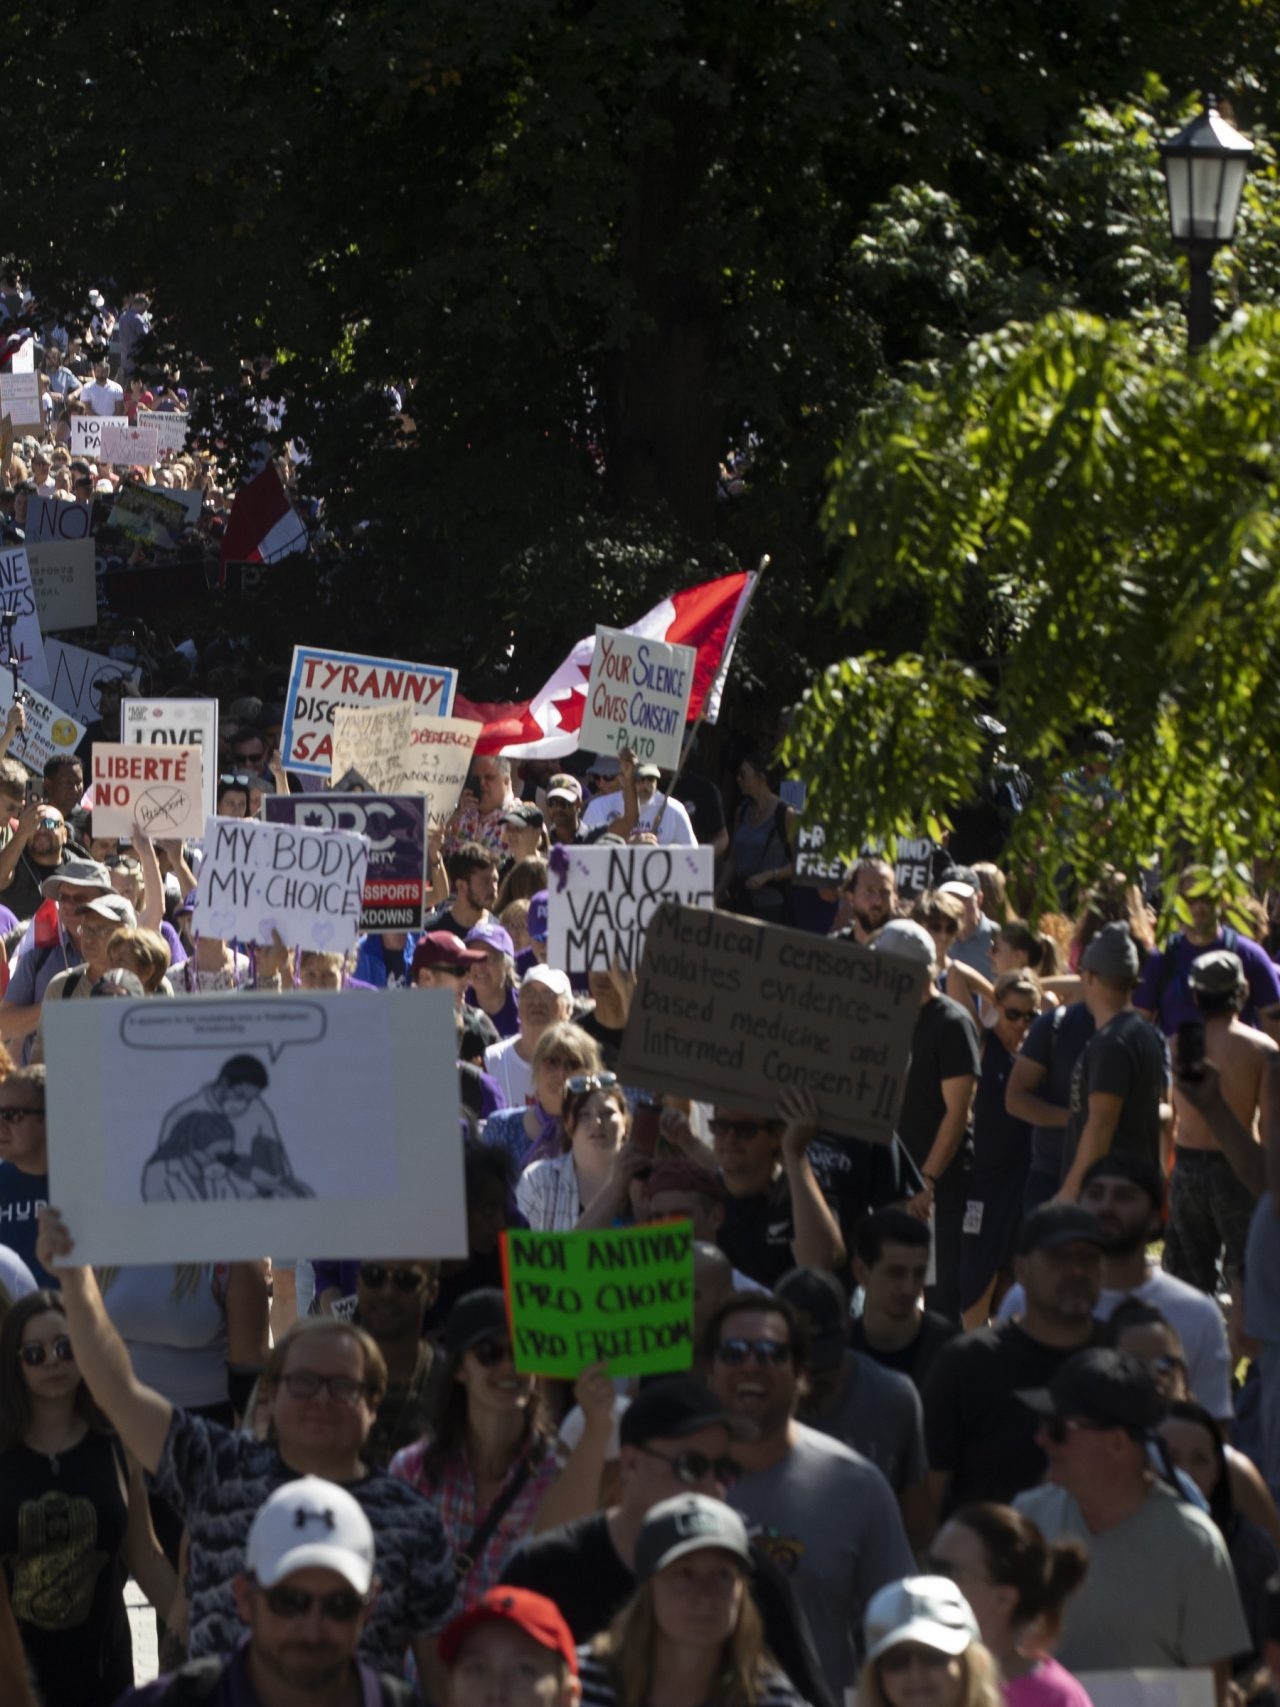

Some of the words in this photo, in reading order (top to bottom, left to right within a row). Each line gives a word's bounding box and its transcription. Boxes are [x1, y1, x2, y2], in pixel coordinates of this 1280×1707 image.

[77, 421, 99, 434] NO
[84, 436, 100, 449] PA
[40, 500, 88, 540] NO
[304, 660, 445, 704] TYRANNY
[599, 637, 632, 685] YOUR
[633, 645, 686, 698] SILENCE
[21, 688, 54, 721] Fact:
[592, 683, 628, 723] GIVES
[630, 691, 680, 736] CONSENT
[33, 730, 56, 753] been
[292, 732, 333, 763] SA
[95, 751, 190, 782] LIBERTÉ
[95, 783, 130, 807] NO
[215, 826, 256, 865] MY
[273, 831, 367, 886] BODY
[608, 849, 672, 902] NO
[208, 867, 256, 909] MY
[266, 874, 362, 916] CHOICE
[655, 908, 766, 962] Medical
[778, 943, 916, 1006] censorship
[642, 980, 714, 1022] based
[730, 1010, 831, 1054] medicine
[850, 1041, 888, 1067] and
[643, 1018, 744, 1070] Informed
[513, 1238, 566, 1272] NOT
[515, 1280, 581, 1314] PRO
[596, 1278, 687, 1314] CHOICE
[515, 1327, 567, 1358] PRO
[574, 1320, 693, 1361] FREEDOM
